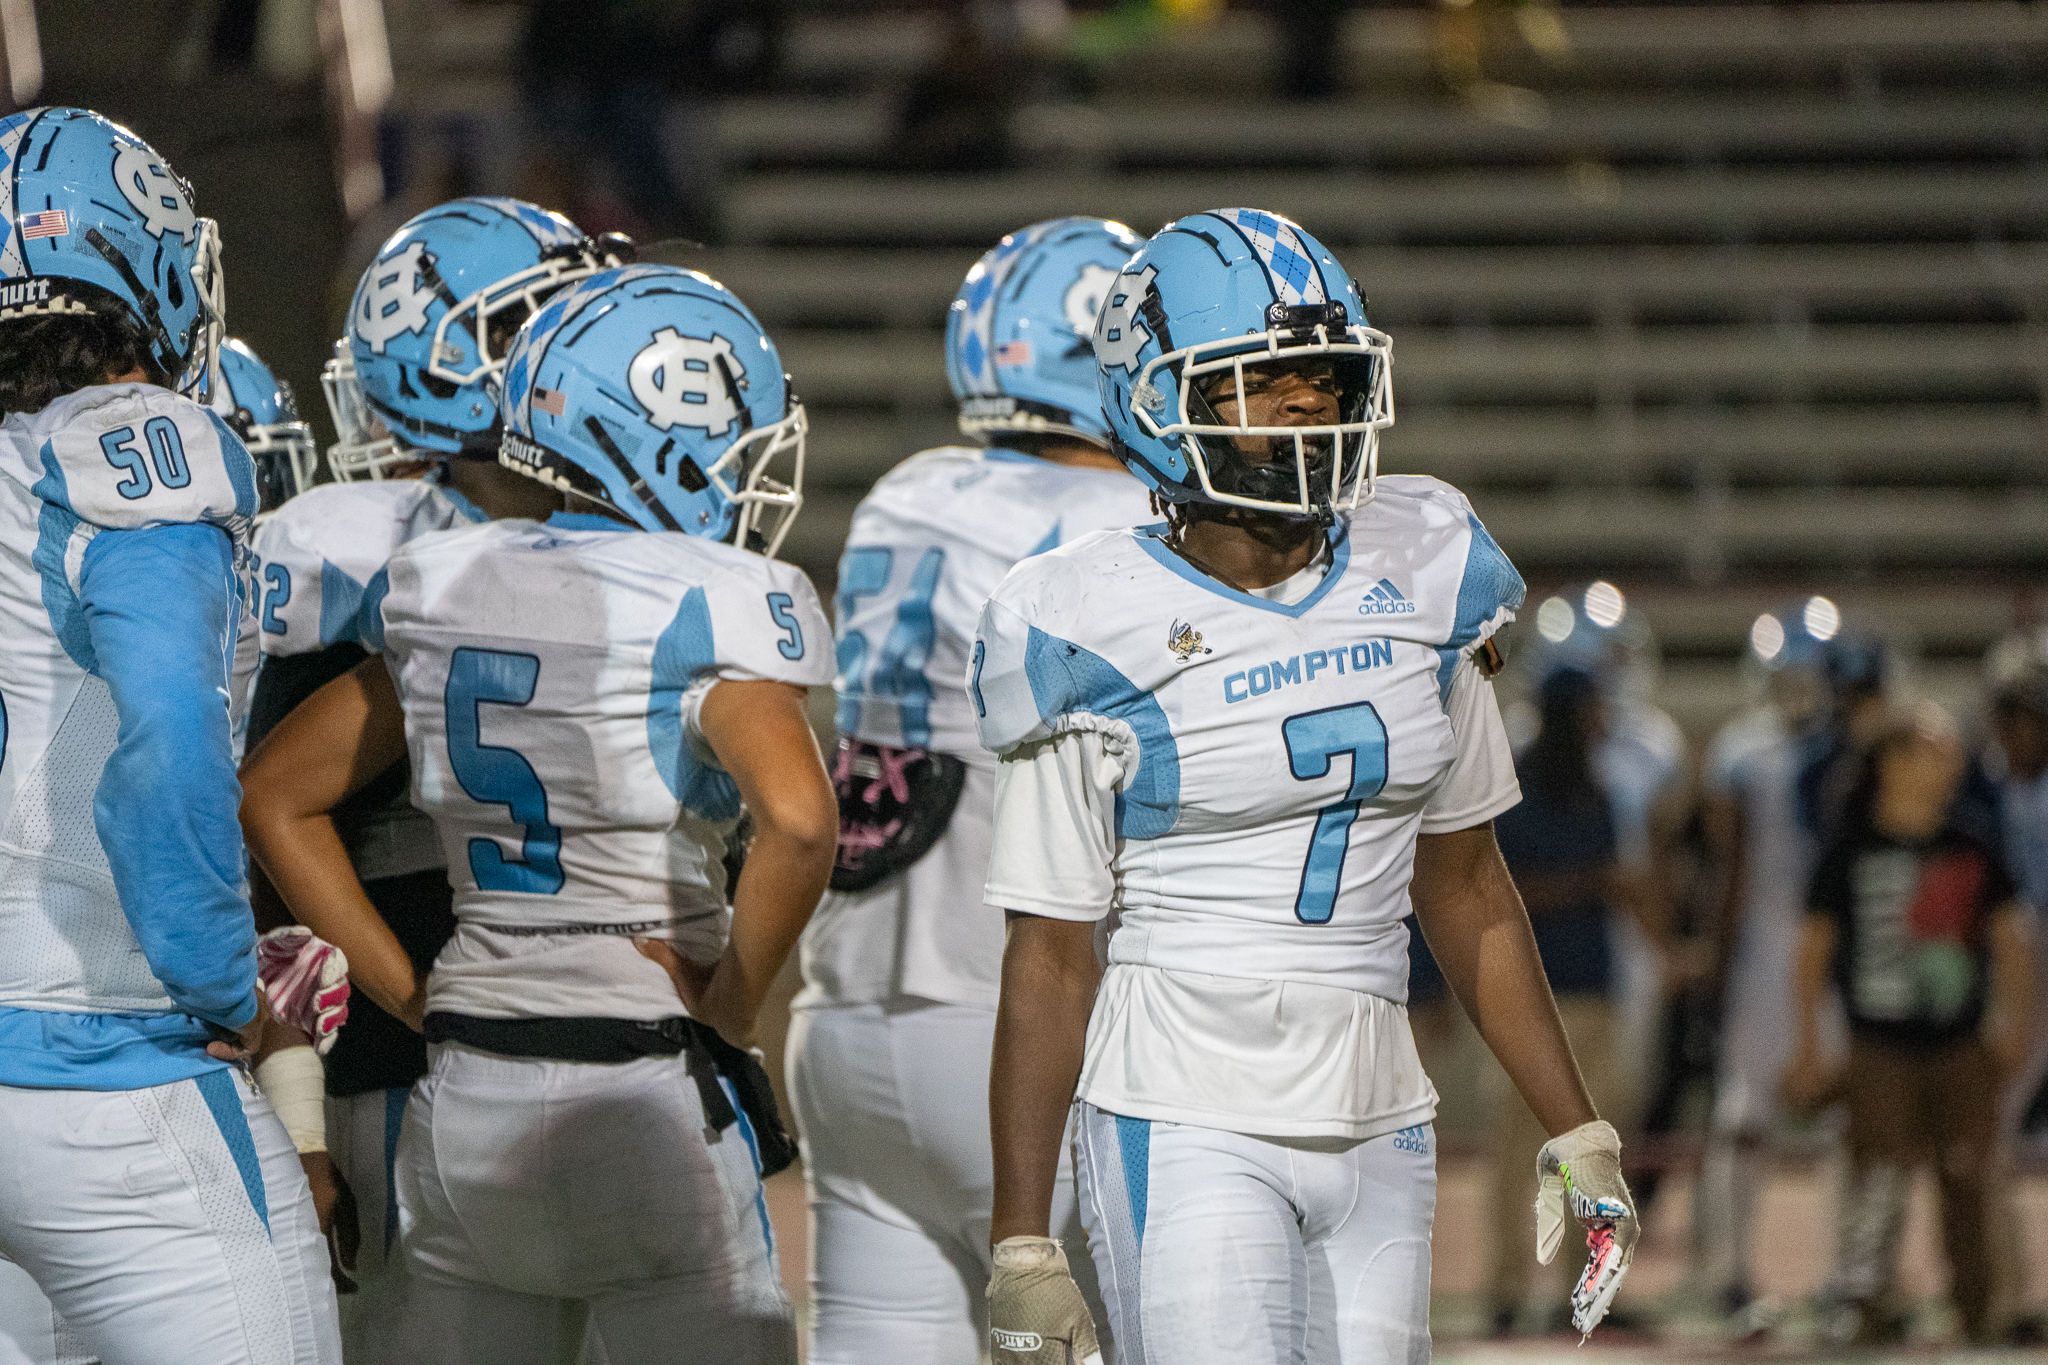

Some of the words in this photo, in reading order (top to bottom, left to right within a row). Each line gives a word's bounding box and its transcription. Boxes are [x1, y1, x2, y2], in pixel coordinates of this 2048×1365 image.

[99, 415, 192, 500] 50
[766, 592, 805, 661] 5
[1358, 600, 1415, 615] adidas
[1223, 638, 1393, 704] COMPTON
[445, 646, 566, 895] 5
[1282, 700, 1389, 924] 7
